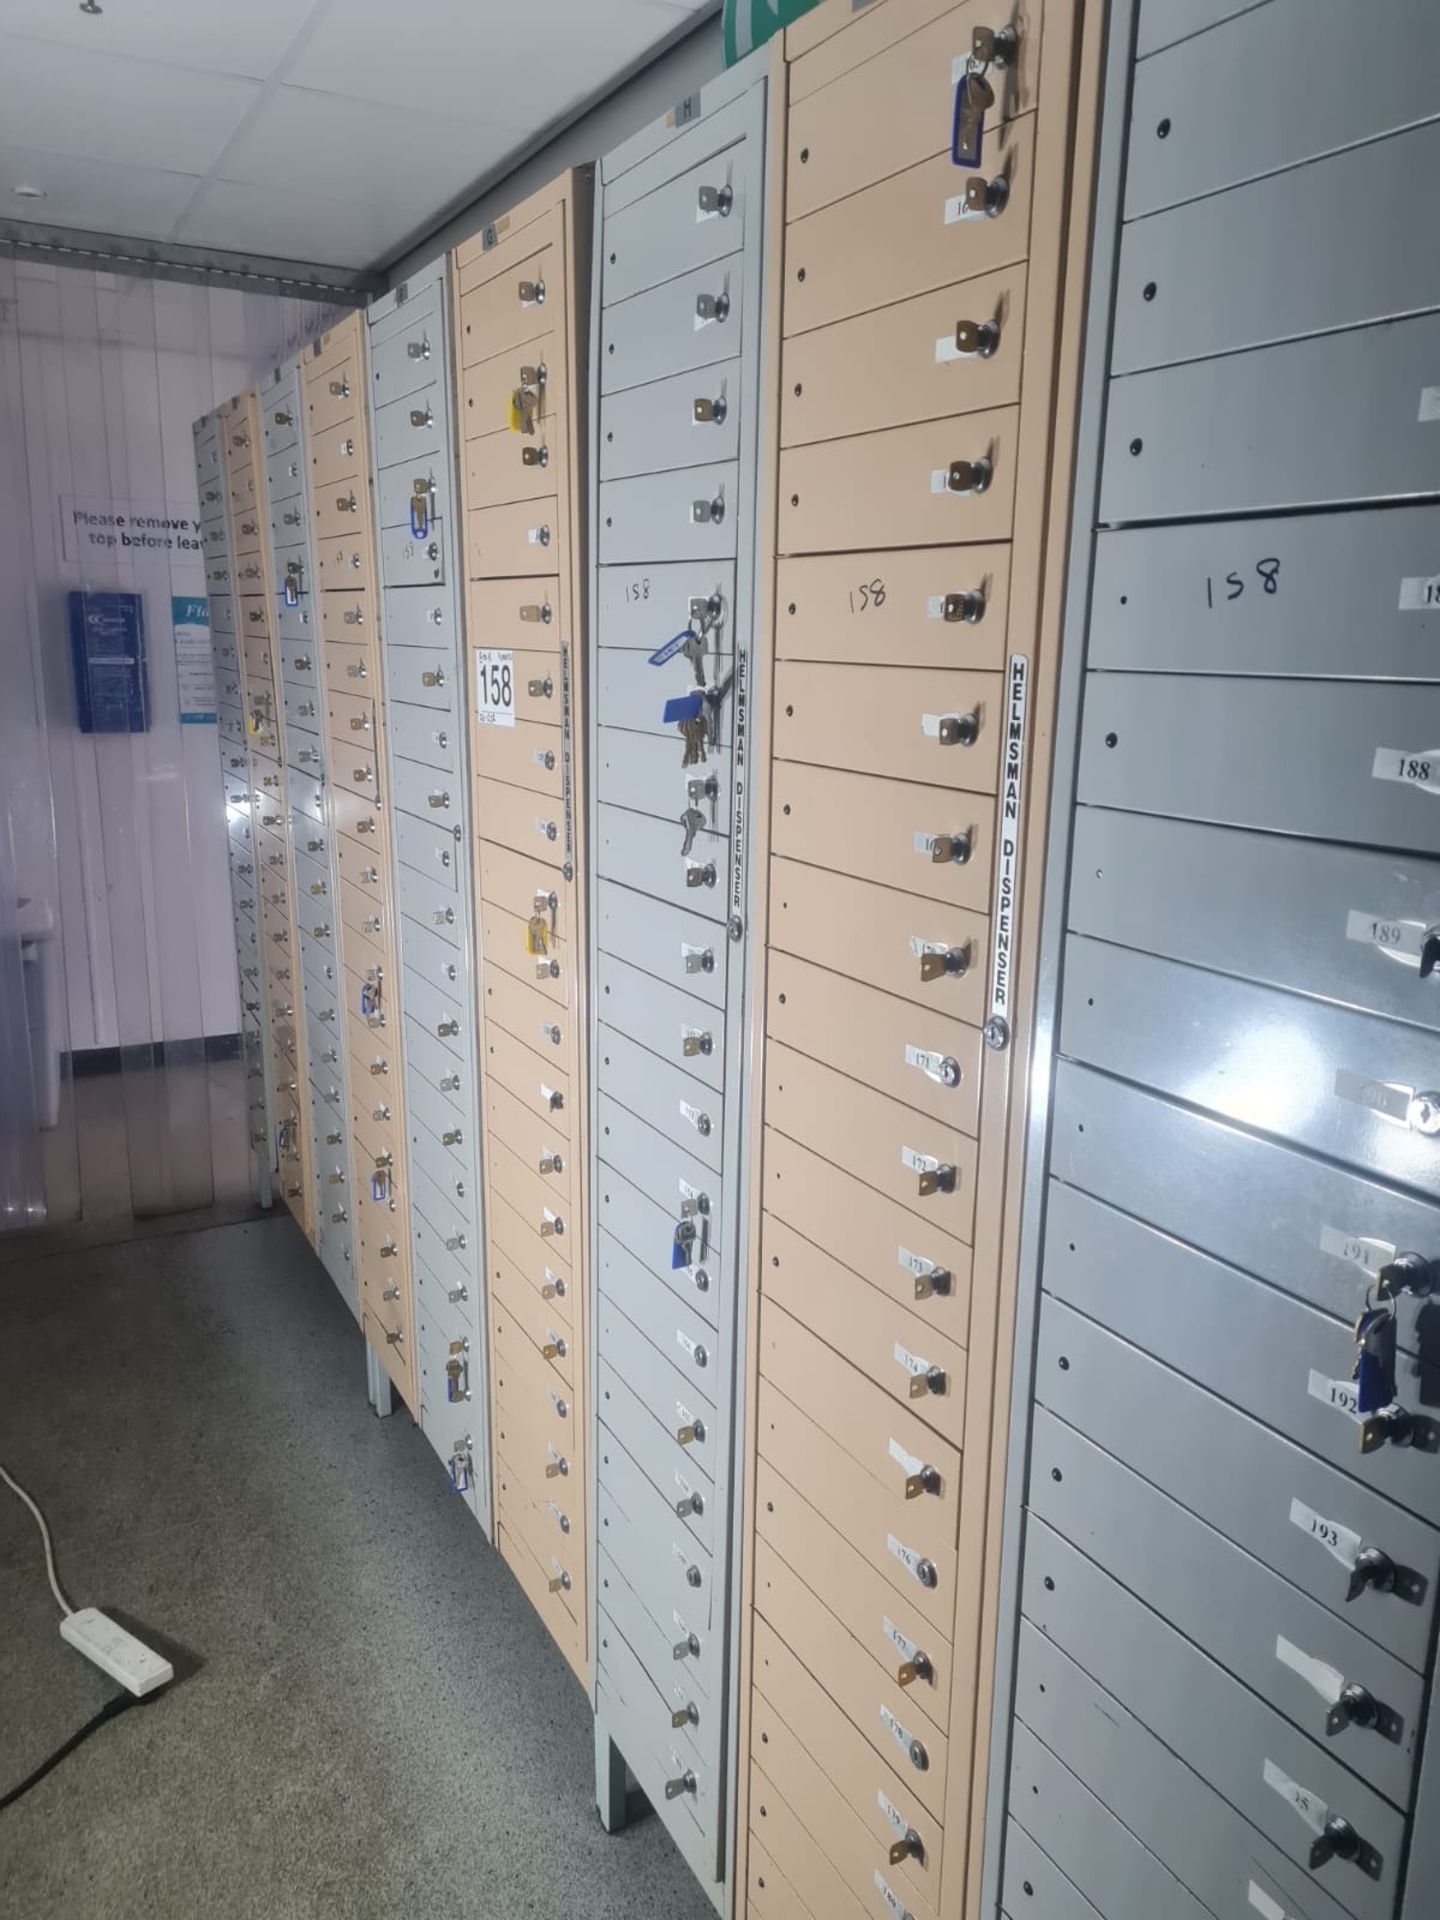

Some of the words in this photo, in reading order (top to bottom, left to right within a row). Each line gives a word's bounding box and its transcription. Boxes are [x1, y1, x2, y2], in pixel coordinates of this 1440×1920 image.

[73, 511, 125, 527] Please
[129, 515, 189, 530] remove
[88, 532, 117, 549] top
[121, 531, 173, 549] before
[625, 577, 650, 603] 158
[849, 578, 887, 614] 158
[1205, 557, 1281, 608] 158
[480, 664, 512, 708] 158
[737, 650, 746, 767] HELMSMAN
[1005, 662, 1025, 819] HELMSMAN
[1398, 758, 1431, 780] 188
[733, 781, 744, 908] DISPENSER
[995, 840, 1014, 1005] DISPENSER
[1369, 922, 1402, 945] 189
[916, 1053, 930, 1068] 171
[912, 1155, 926, 1171] 172
[908, 1256, 923, 1273] 173
[1344, 1242, 1369, 1264] 191
[1331, 1387, 1357, 1415] 192
[1310, 1517, 1338, 1547] 193
